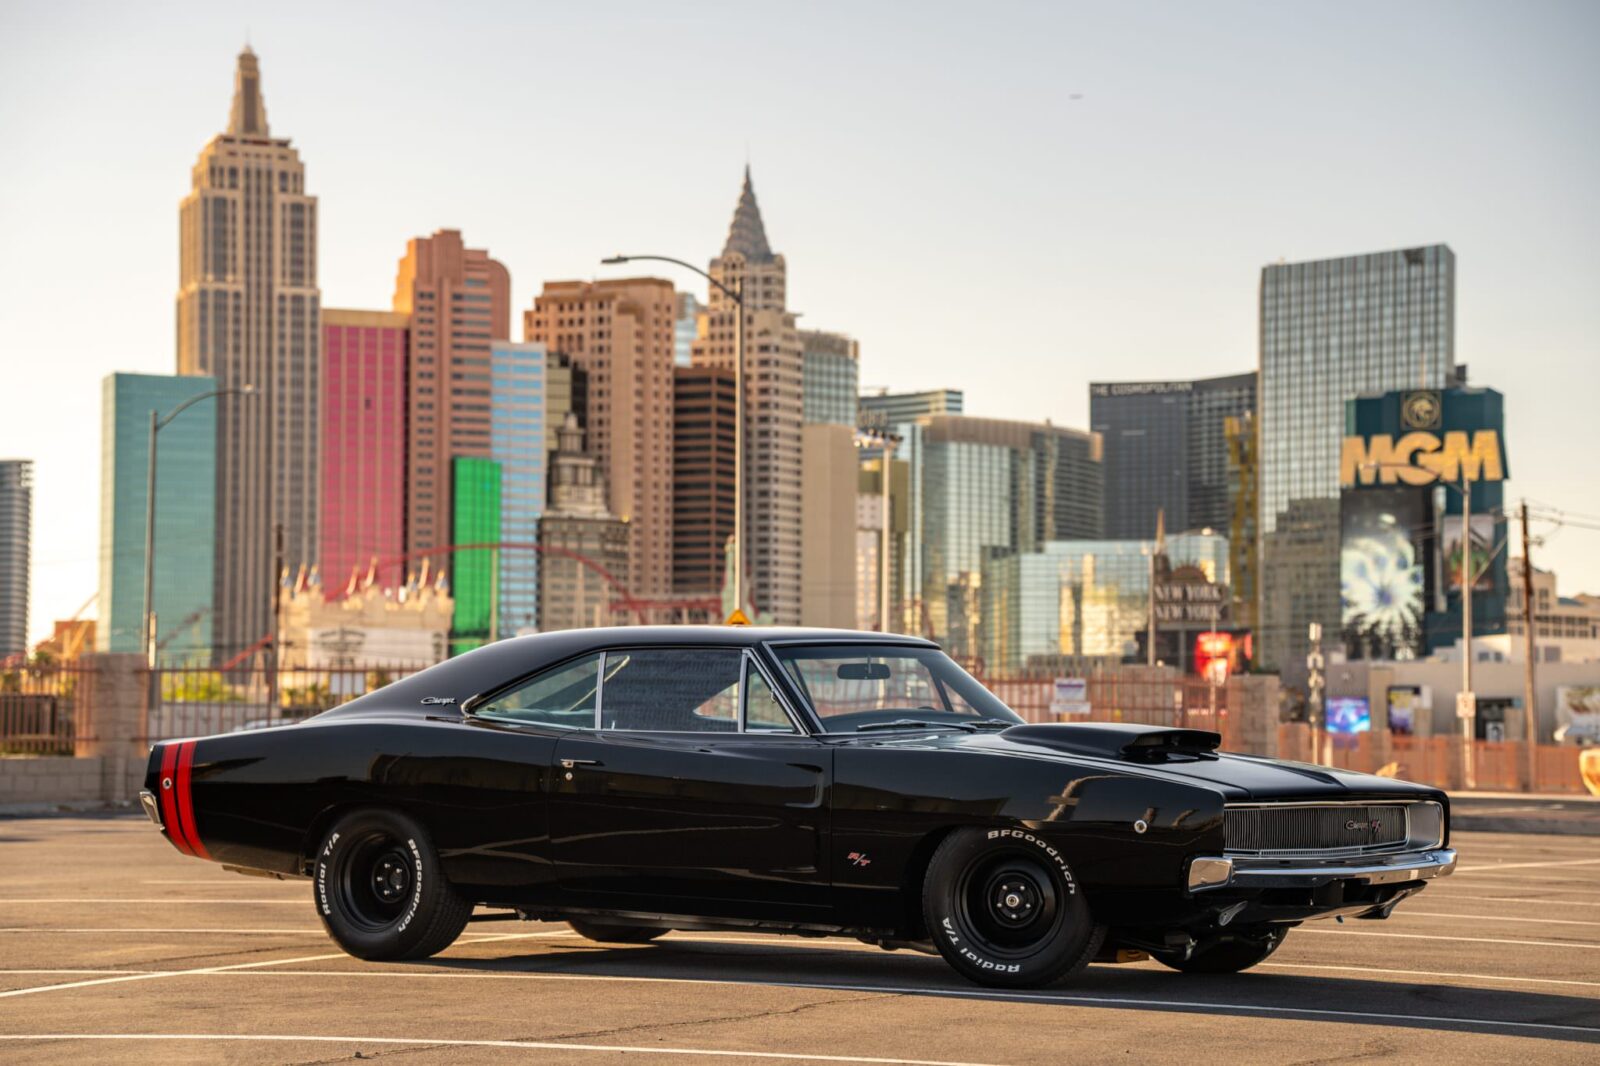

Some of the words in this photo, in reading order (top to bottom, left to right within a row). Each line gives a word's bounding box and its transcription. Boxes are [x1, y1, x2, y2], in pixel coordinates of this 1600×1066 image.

[1340, 429, 1503, 486] MGM
[1155, 586, 1183, 600] NEW
[1186, 584, 1221, 600] YORK
[1155, 604, 1183, 620] NEW
[323, 832, 341, 857] T/A
[987, 829, 1076, 895] BFGoodrich
[319, 863, 332, 915] Radial
[398, 838, 422, 932] BFGoodrich
[942, 917, 960, 946] T/A
[960, 947, 1021, 973] Radial
